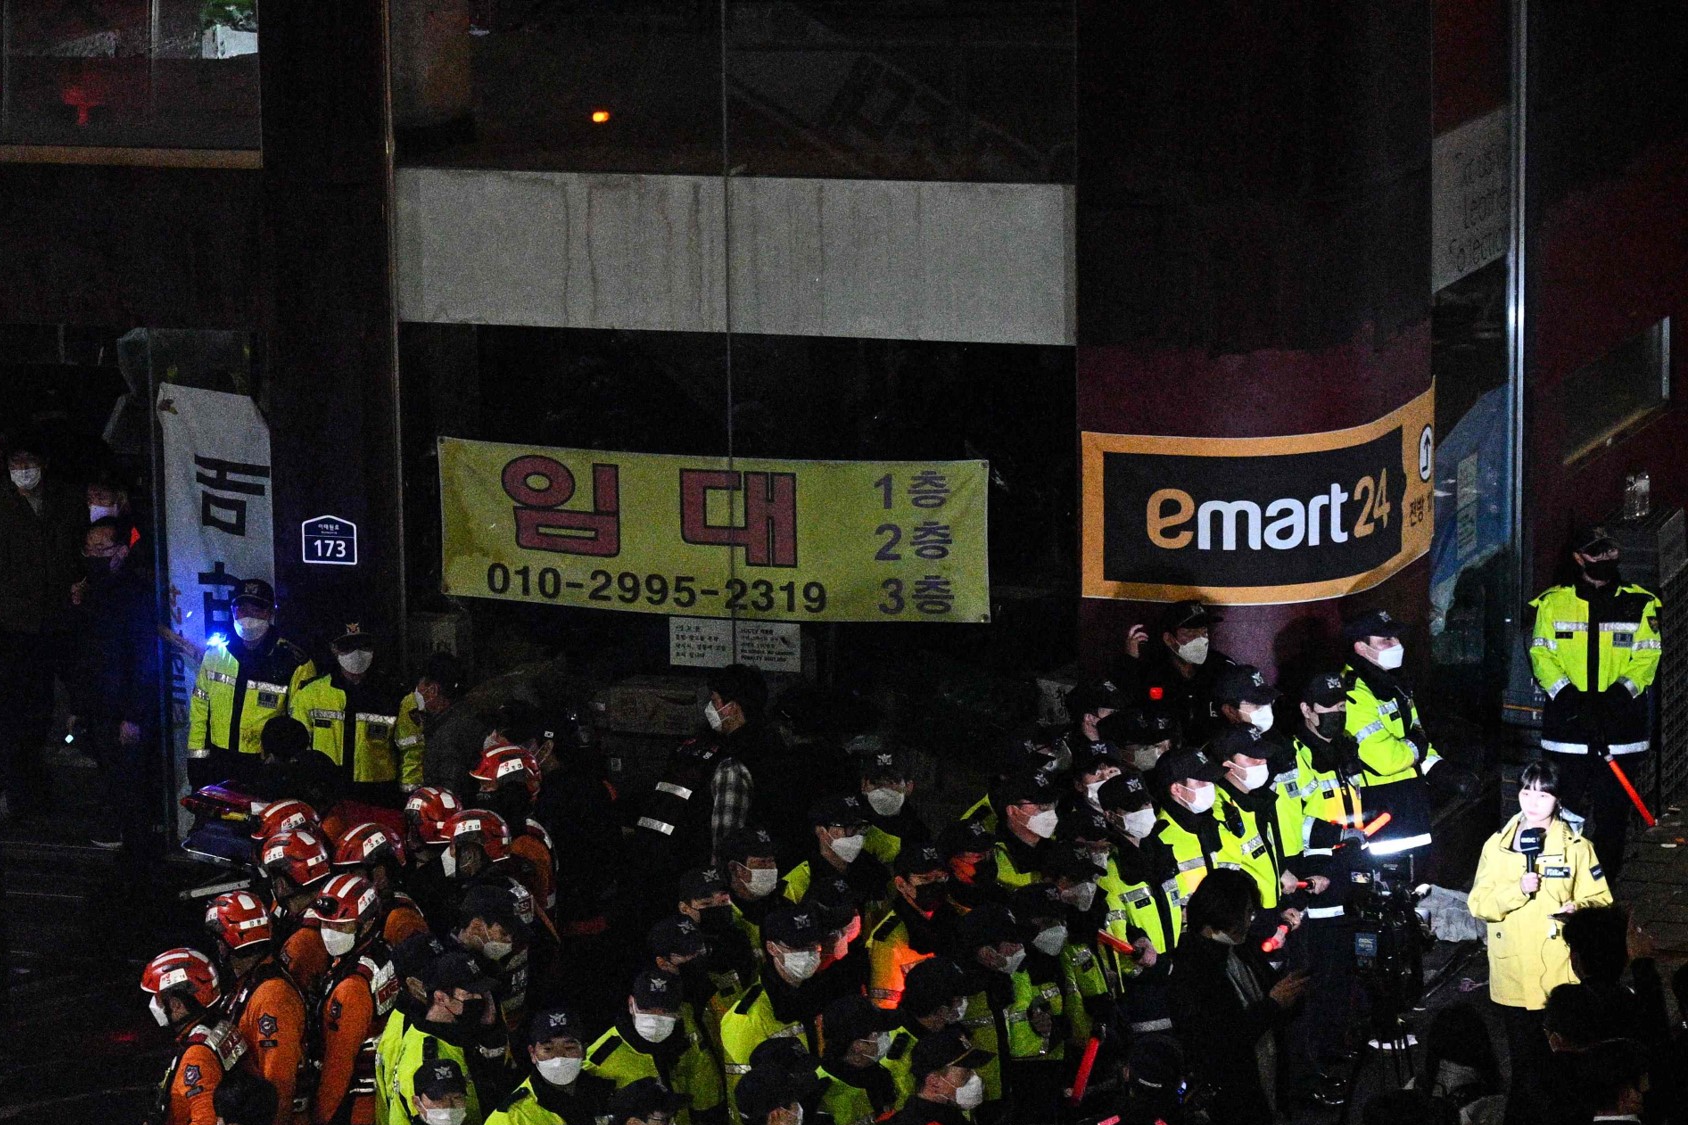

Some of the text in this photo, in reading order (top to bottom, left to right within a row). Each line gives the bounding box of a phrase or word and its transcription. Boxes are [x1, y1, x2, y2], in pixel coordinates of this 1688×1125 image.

[873, 471, 951, 510] 1층
[1146, 467, 1392, 551] emart24
[501, 455, 798, 568] 임대
[314, 539, 346, 557] 173
[873, 522, 952, 562] 2층
[487, 562, 827, 614] 010-2995-2319
[878, 576, 954, 616] 3층
